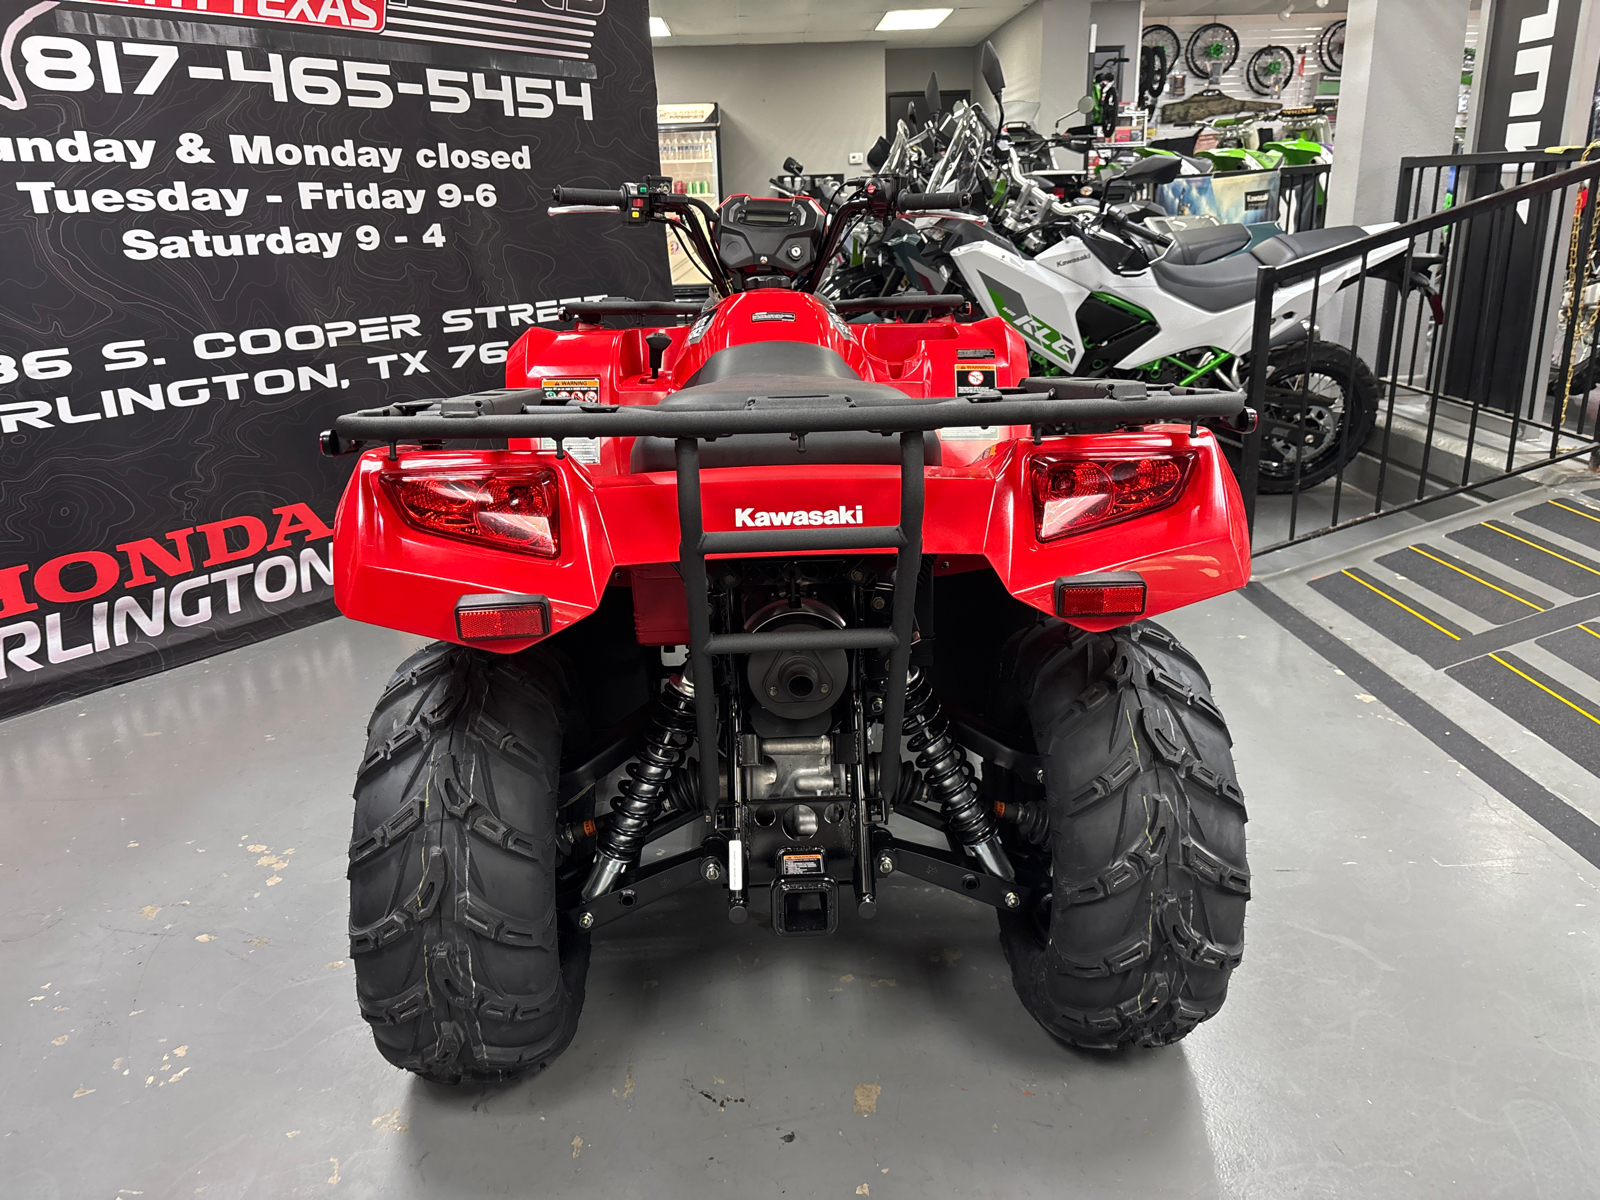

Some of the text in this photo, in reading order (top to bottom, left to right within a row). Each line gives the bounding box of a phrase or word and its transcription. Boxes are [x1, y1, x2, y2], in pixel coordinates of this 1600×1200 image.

[21, 35, 594, 121] 817-465-5454
[176, 133, 215, 163] &
[229, 135, 402, 173] Monday
[416, 143, 531, 169] closed
[16, 181, 497, 216] Tuesday - Friday 9-6
[123, 226, 342, 260] Saturday
[356, 225, 380, 250] 9
[422, 223, 446, 247] 4
[1056, 253, 1091, 267] Kawasaki
[102, 340, 166, 371] S.
[193, 312, 422, 361] COOPER
[442, 294, 608, 334] STRE
[367, 350, 430, 379] TX
[735, 505, 863, 527] Kawasaki
